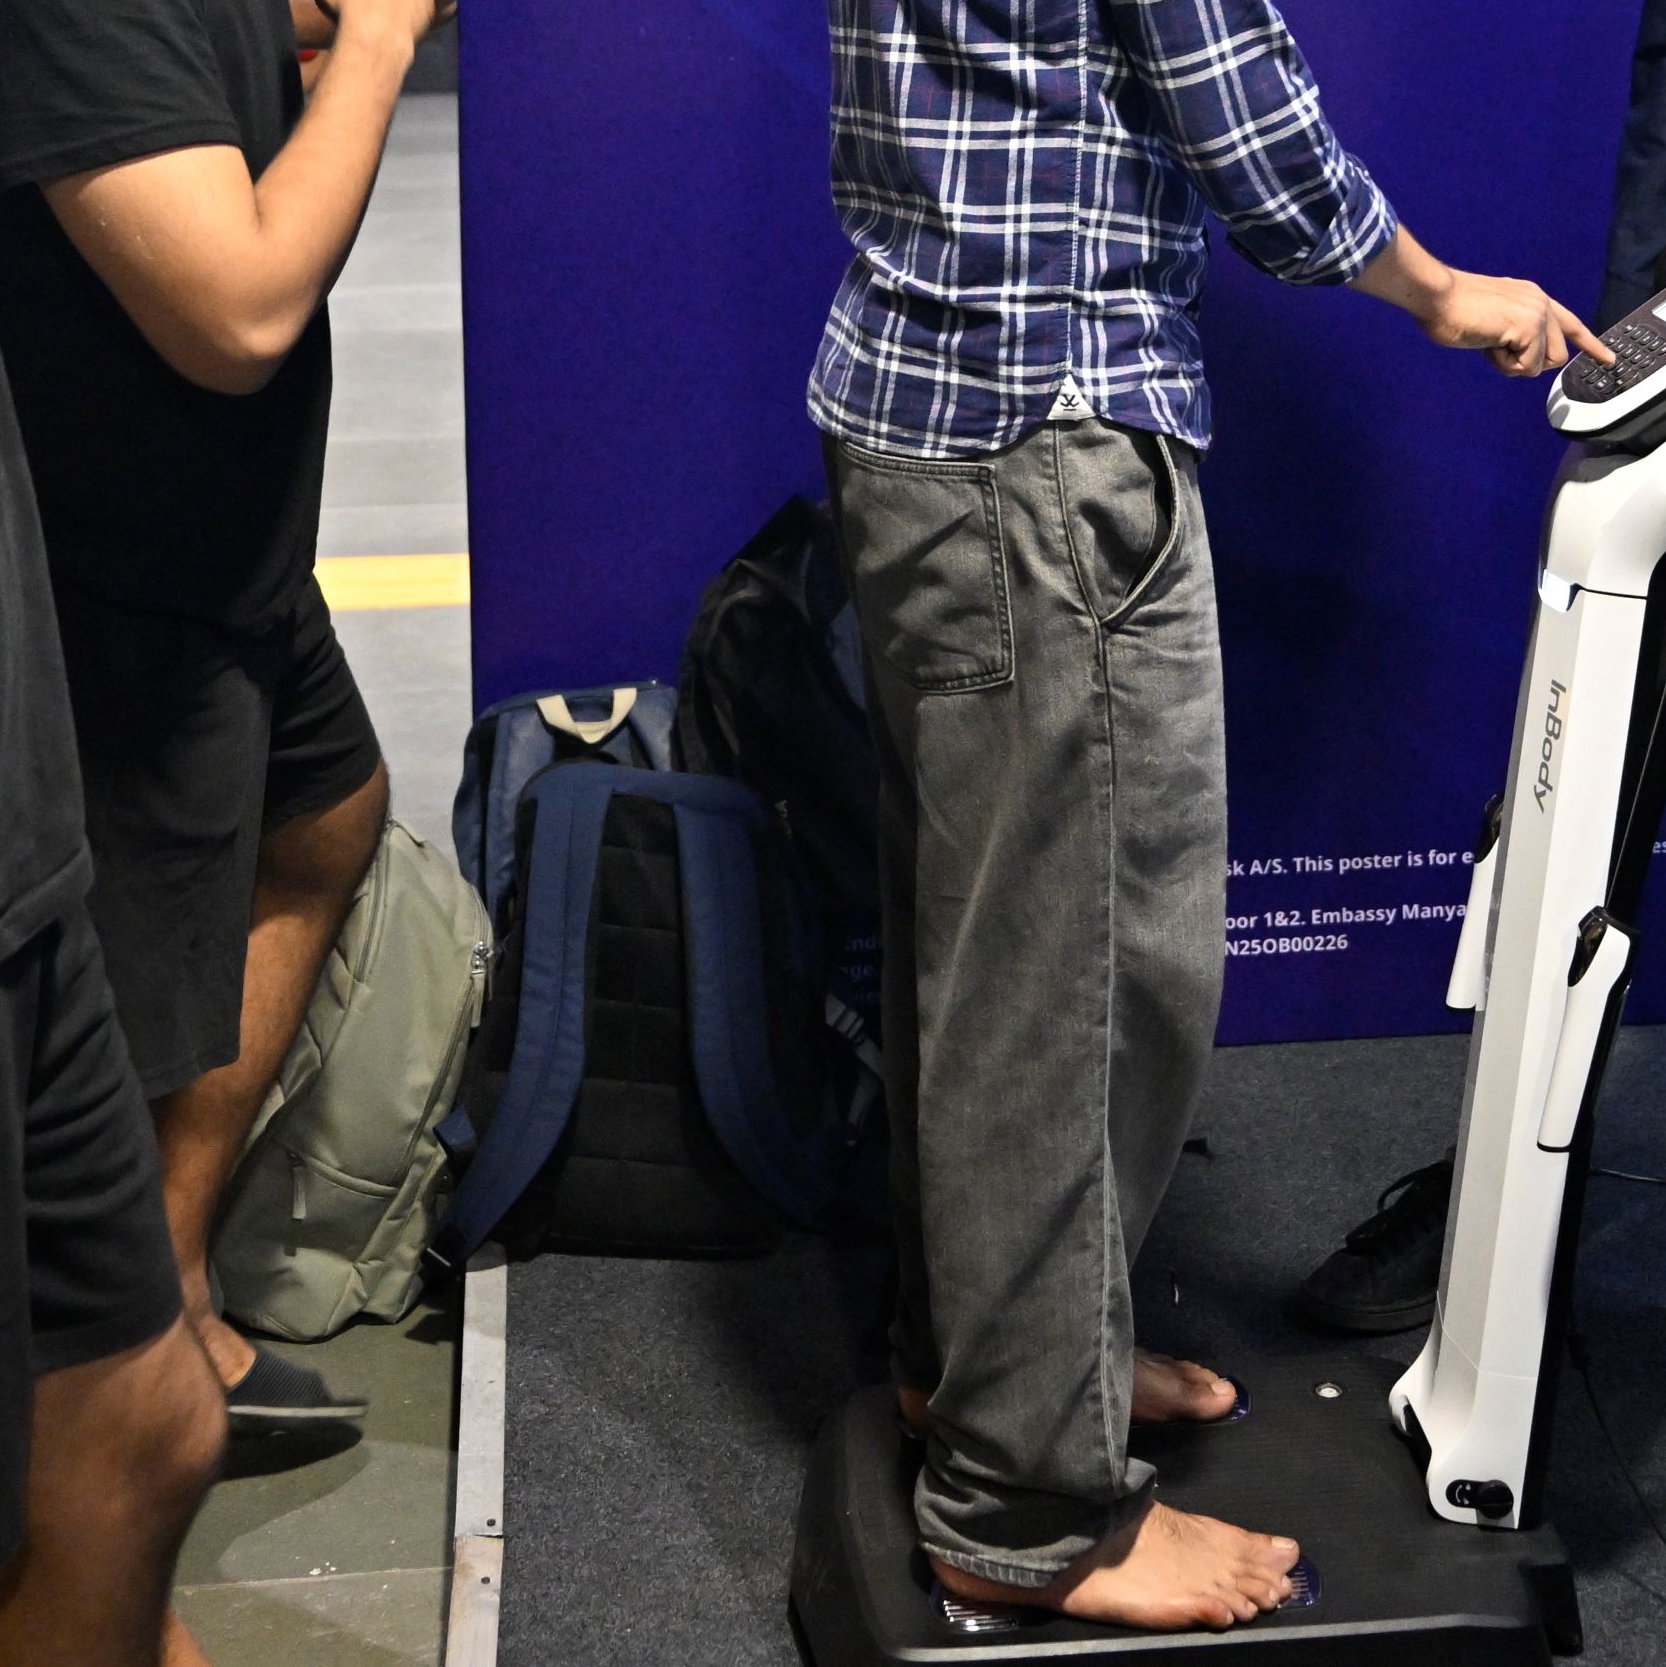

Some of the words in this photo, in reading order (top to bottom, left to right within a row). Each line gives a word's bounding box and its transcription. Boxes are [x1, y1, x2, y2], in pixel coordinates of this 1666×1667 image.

[1533, 679, 1567, 813] InBody
[1249, 858, 1288, 875] A/S.
[1293, 855, 1334, 873] This
[1339, 852, 1402, 874] poster
[1407, 850, 1423, 866] is
[1428, 849, 1457, 865] for
[1263, 911, 1306, 928] 1&2.
[1311, 906, 1397, 926] Embassy
